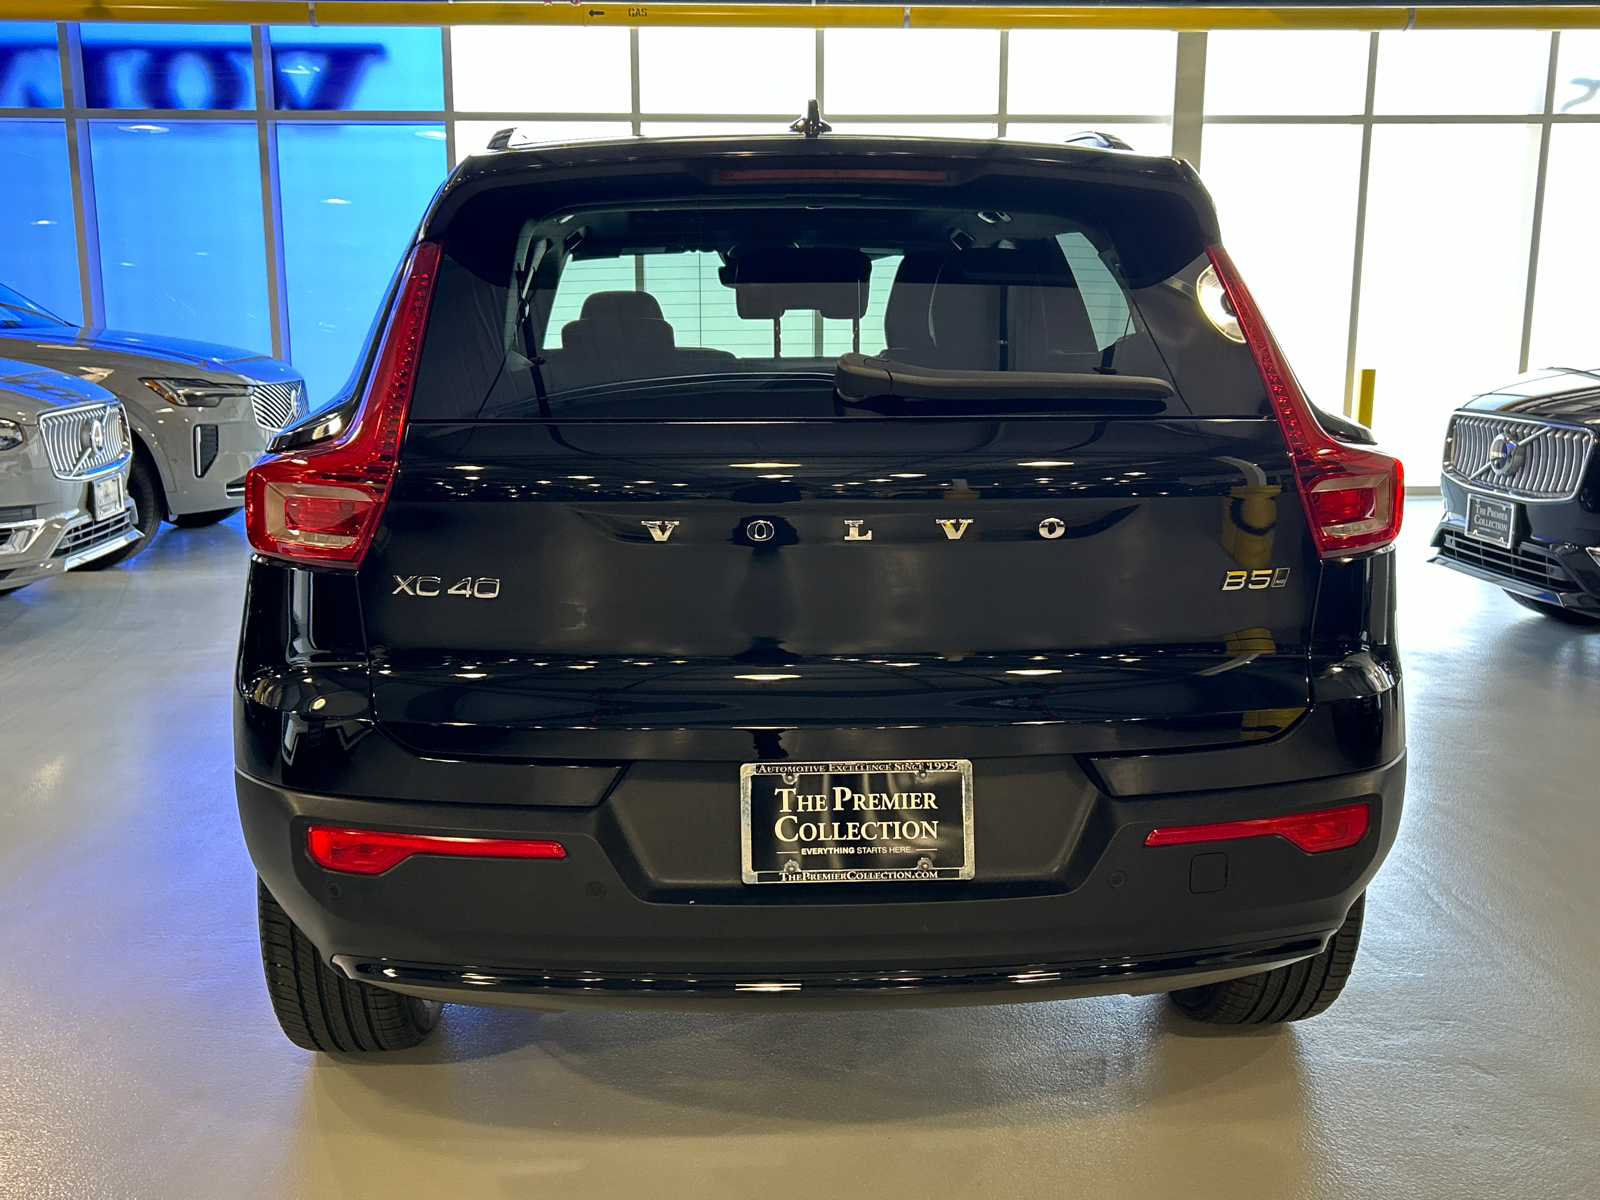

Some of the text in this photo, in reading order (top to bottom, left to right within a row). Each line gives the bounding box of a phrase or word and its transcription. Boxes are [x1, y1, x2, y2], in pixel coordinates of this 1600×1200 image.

[628, 8, 648, 17] GAS
[641, 517, 1066, 541] VOLVO
[758, 761, 957, 774] AUTOMOTIVE EXCELLENCE SINCE 1995
[774, 786, 939, 813] THE PREMIER
[774, 815, 939, 843] COLLECTION
[801, 847, 855, 856] EVERYTHING
[856, 846, 888, 855] STARTS
